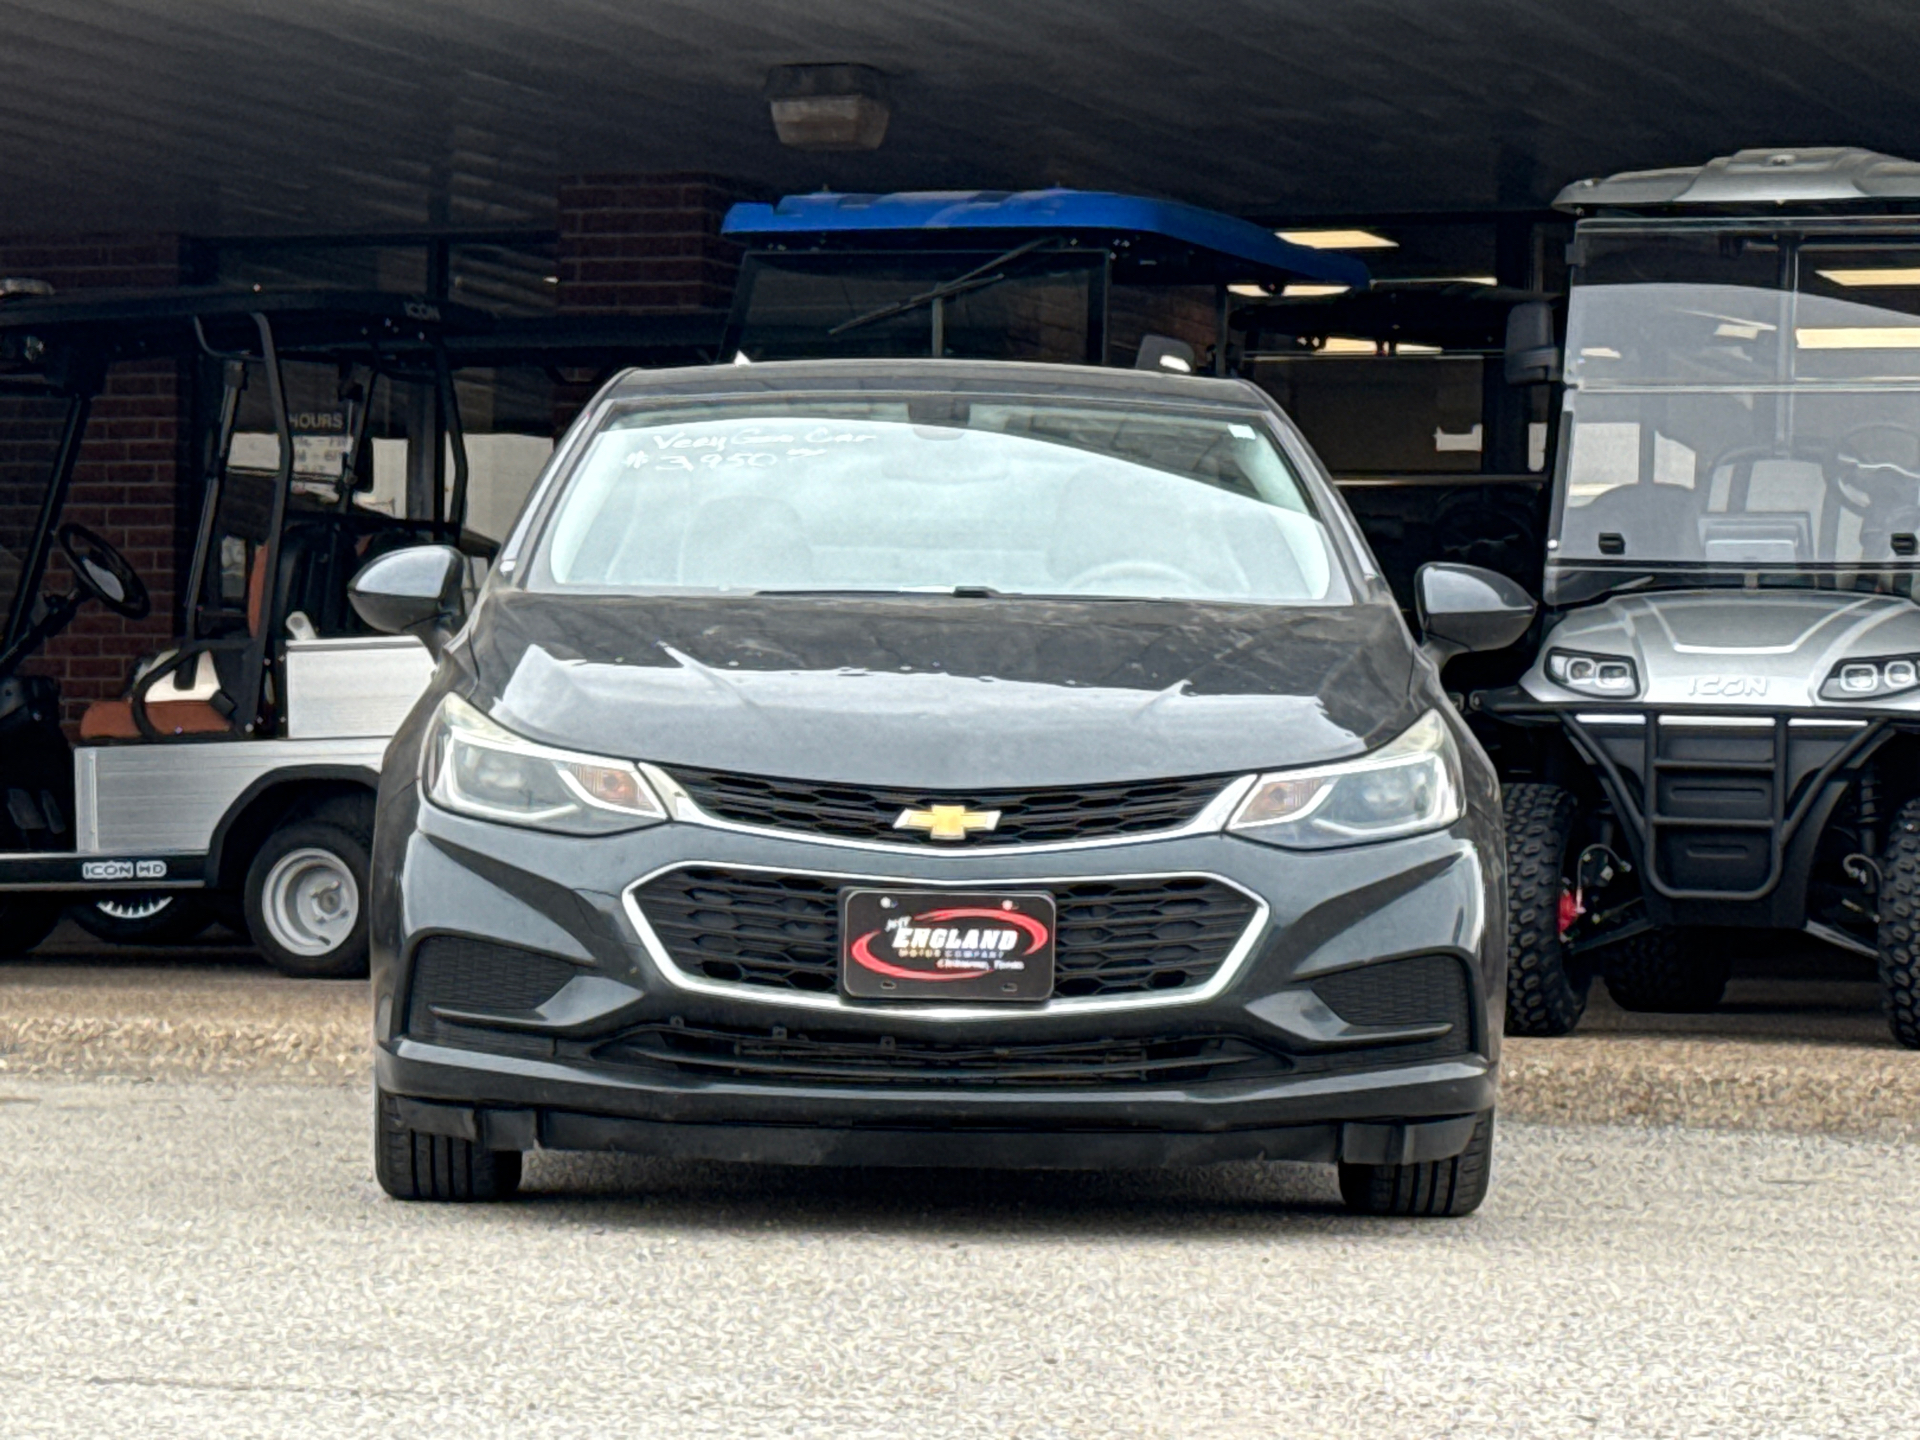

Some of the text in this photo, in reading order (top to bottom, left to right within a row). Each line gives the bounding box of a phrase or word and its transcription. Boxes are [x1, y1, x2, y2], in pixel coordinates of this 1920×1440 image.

[289, 412, 344, 429] HOURS
[1688, 675, 1768, 697] ICON
[83, 861, 167, 879] ICON HD
[892, 928, 1018, 950] ENGLAND
